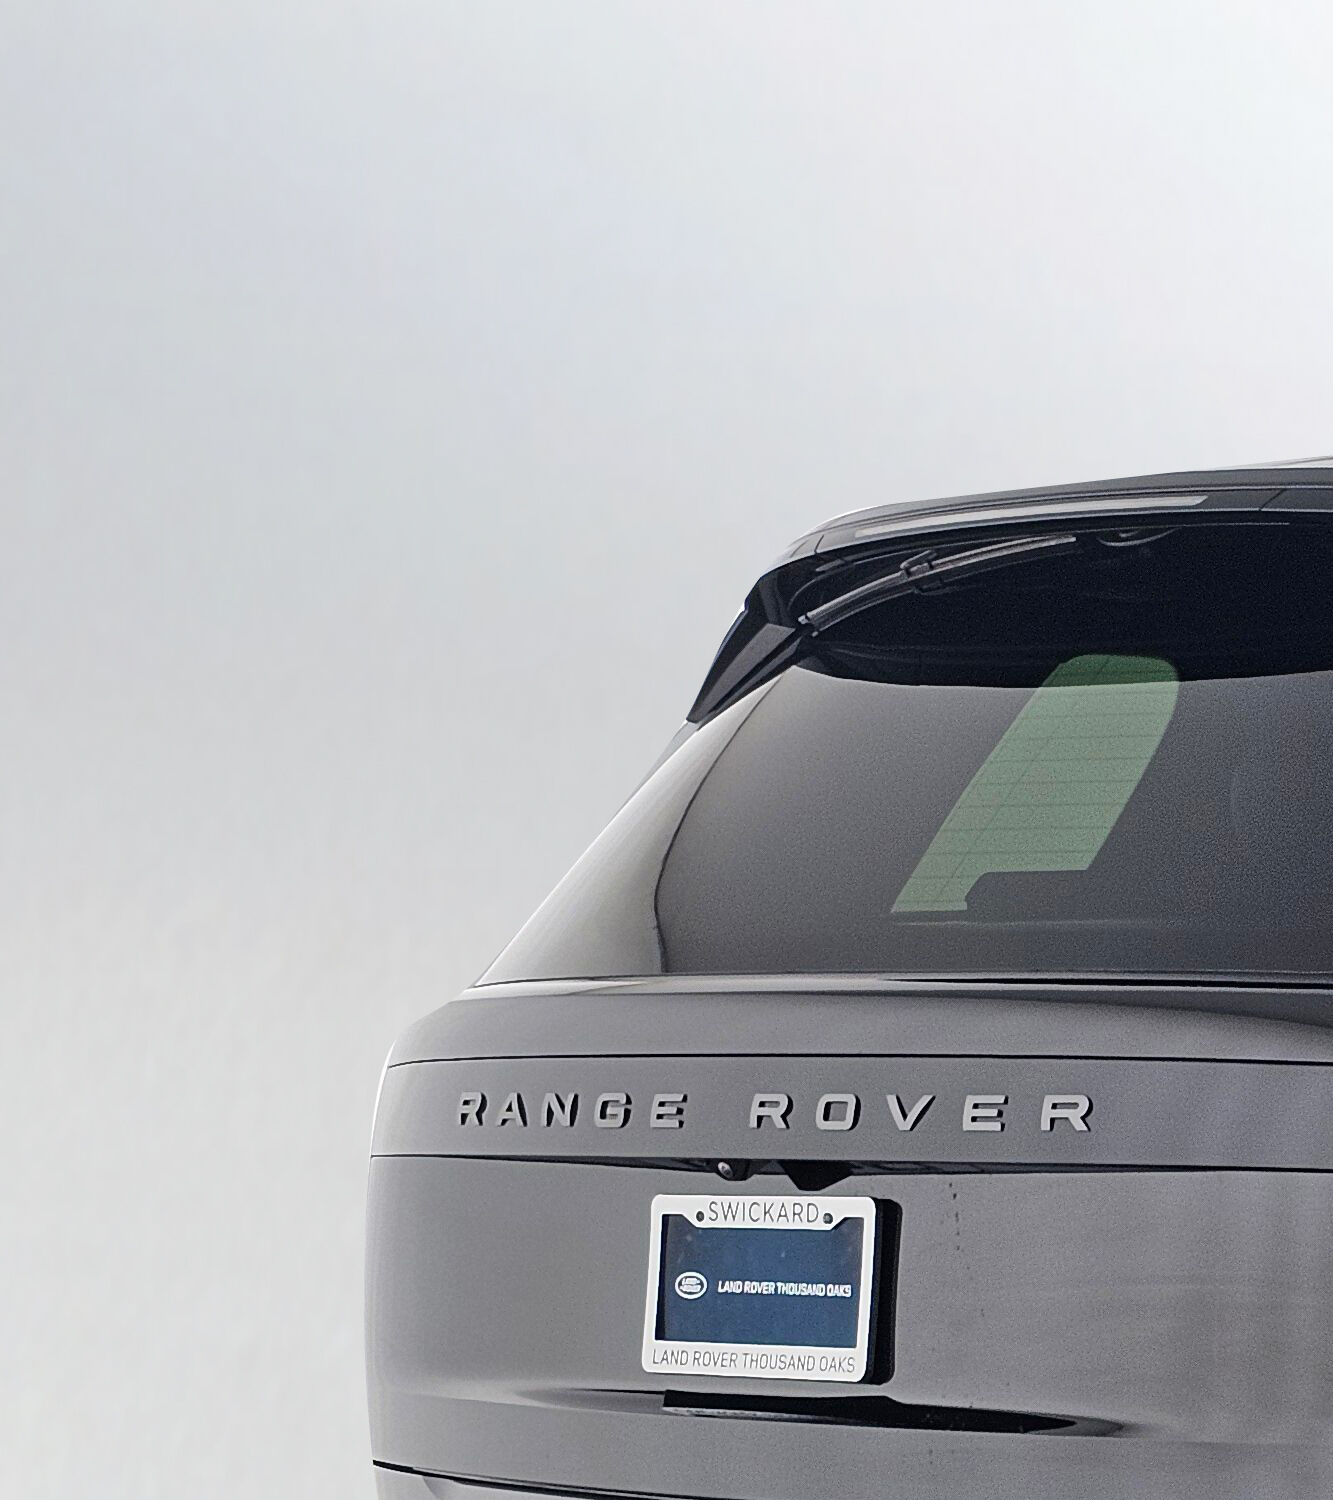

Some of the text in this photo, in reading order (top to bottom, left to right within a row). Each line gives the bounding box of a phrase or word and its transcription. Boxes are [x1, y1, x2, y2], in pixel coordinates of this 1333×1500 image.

[459, 1092, 1094, 1133] RANGE ROVER
[708, 1200, 819, 1223] SWICKARD
[717, 1280, 742, 1294] LAND
[743, 1281, 775, 1295] ROVER
[776, 1282, 825, 1297] THOUSAND
[826, 1284, 852, 1298] OAKS
[652, 1348, 855, 1373] LAND ROVER THOUSAND OAKS
